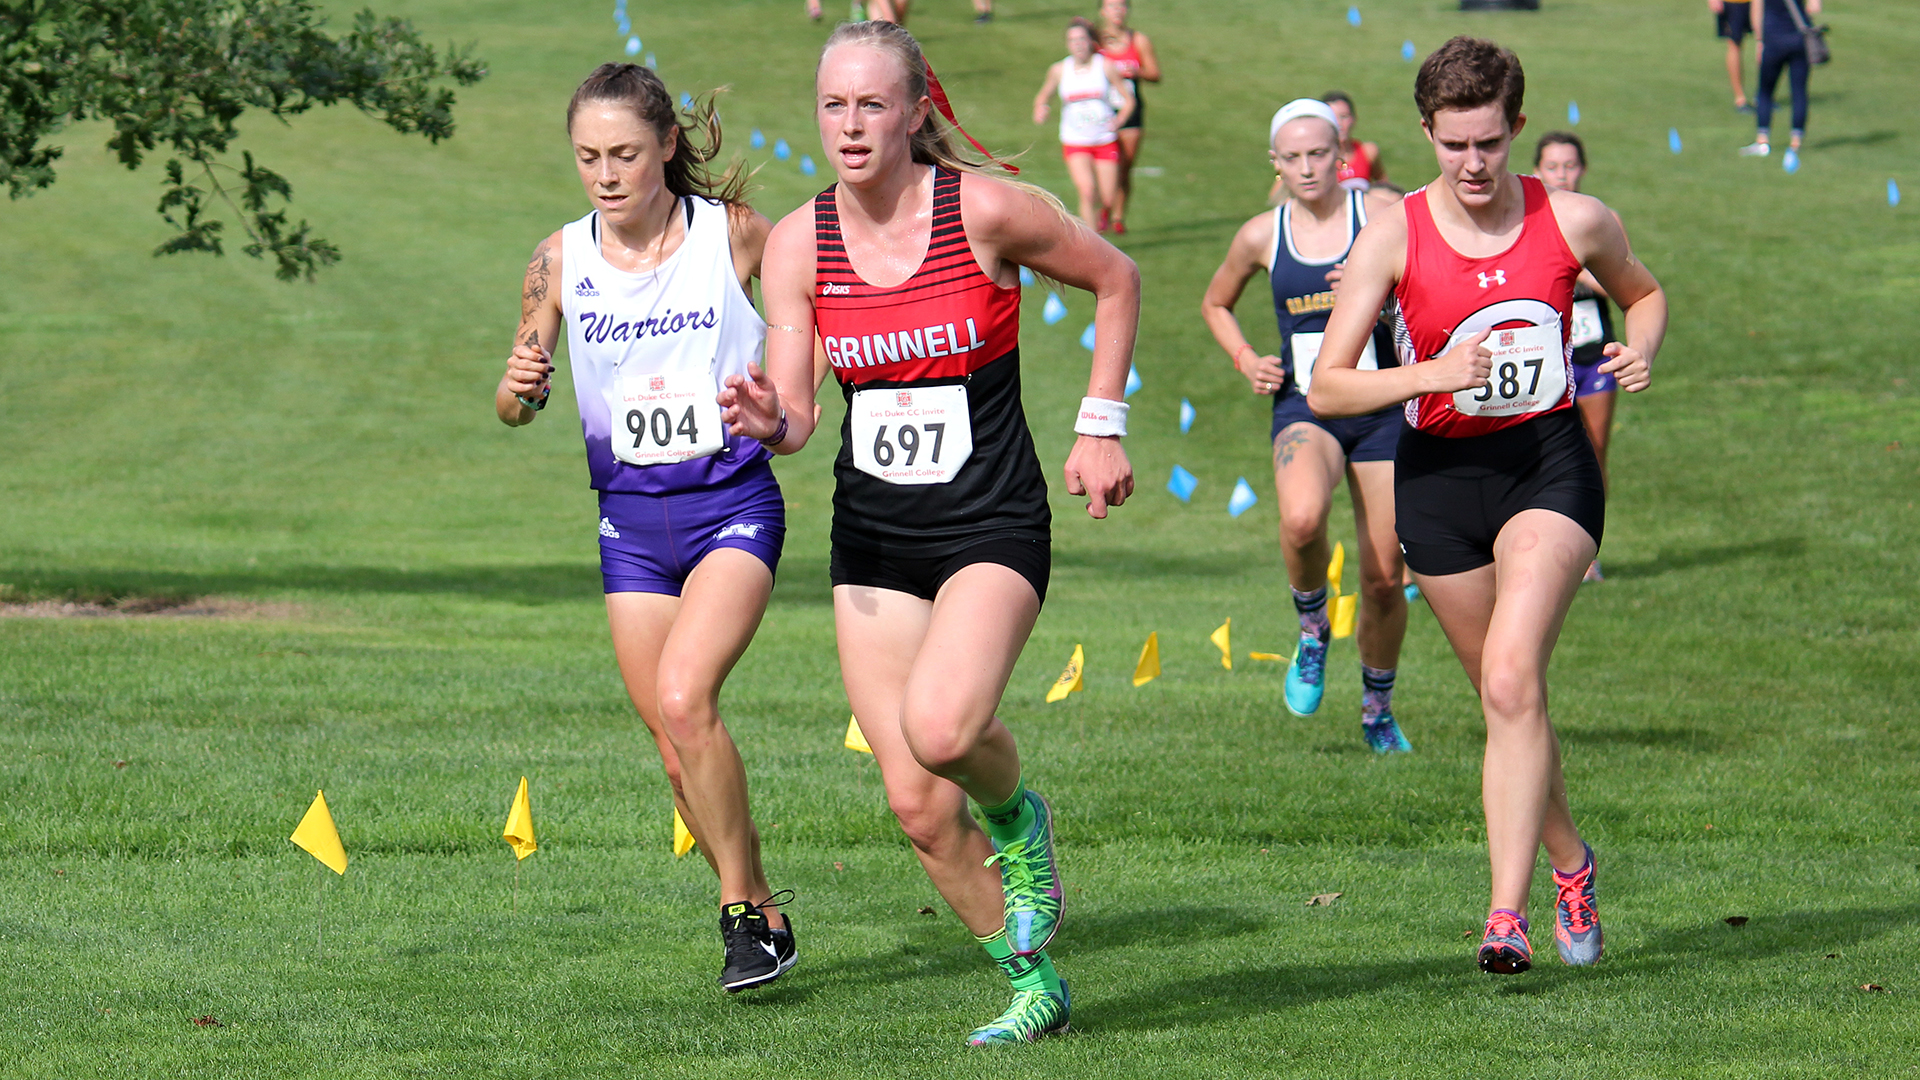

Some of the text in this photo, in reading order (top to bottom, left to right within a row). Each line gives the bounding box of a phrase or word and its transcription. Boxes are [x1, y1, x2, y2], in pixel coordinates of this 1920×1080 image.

[580, 306, 719, 344] Warriors
[825, 317, 986, 369] GRINNELL
[1523, 345, 1545, 353] Invite
[638, 394, 657, 402] Duke
[1480, 400, 1540, 411] Grinnell College
[870, 410, 883, 418] Les
[626, 404, 699, 449] 904
[873, 422, 946, 467] 697
[635, 449, 696, 458] Grinnell College
[915, 469, 945, 477] College
